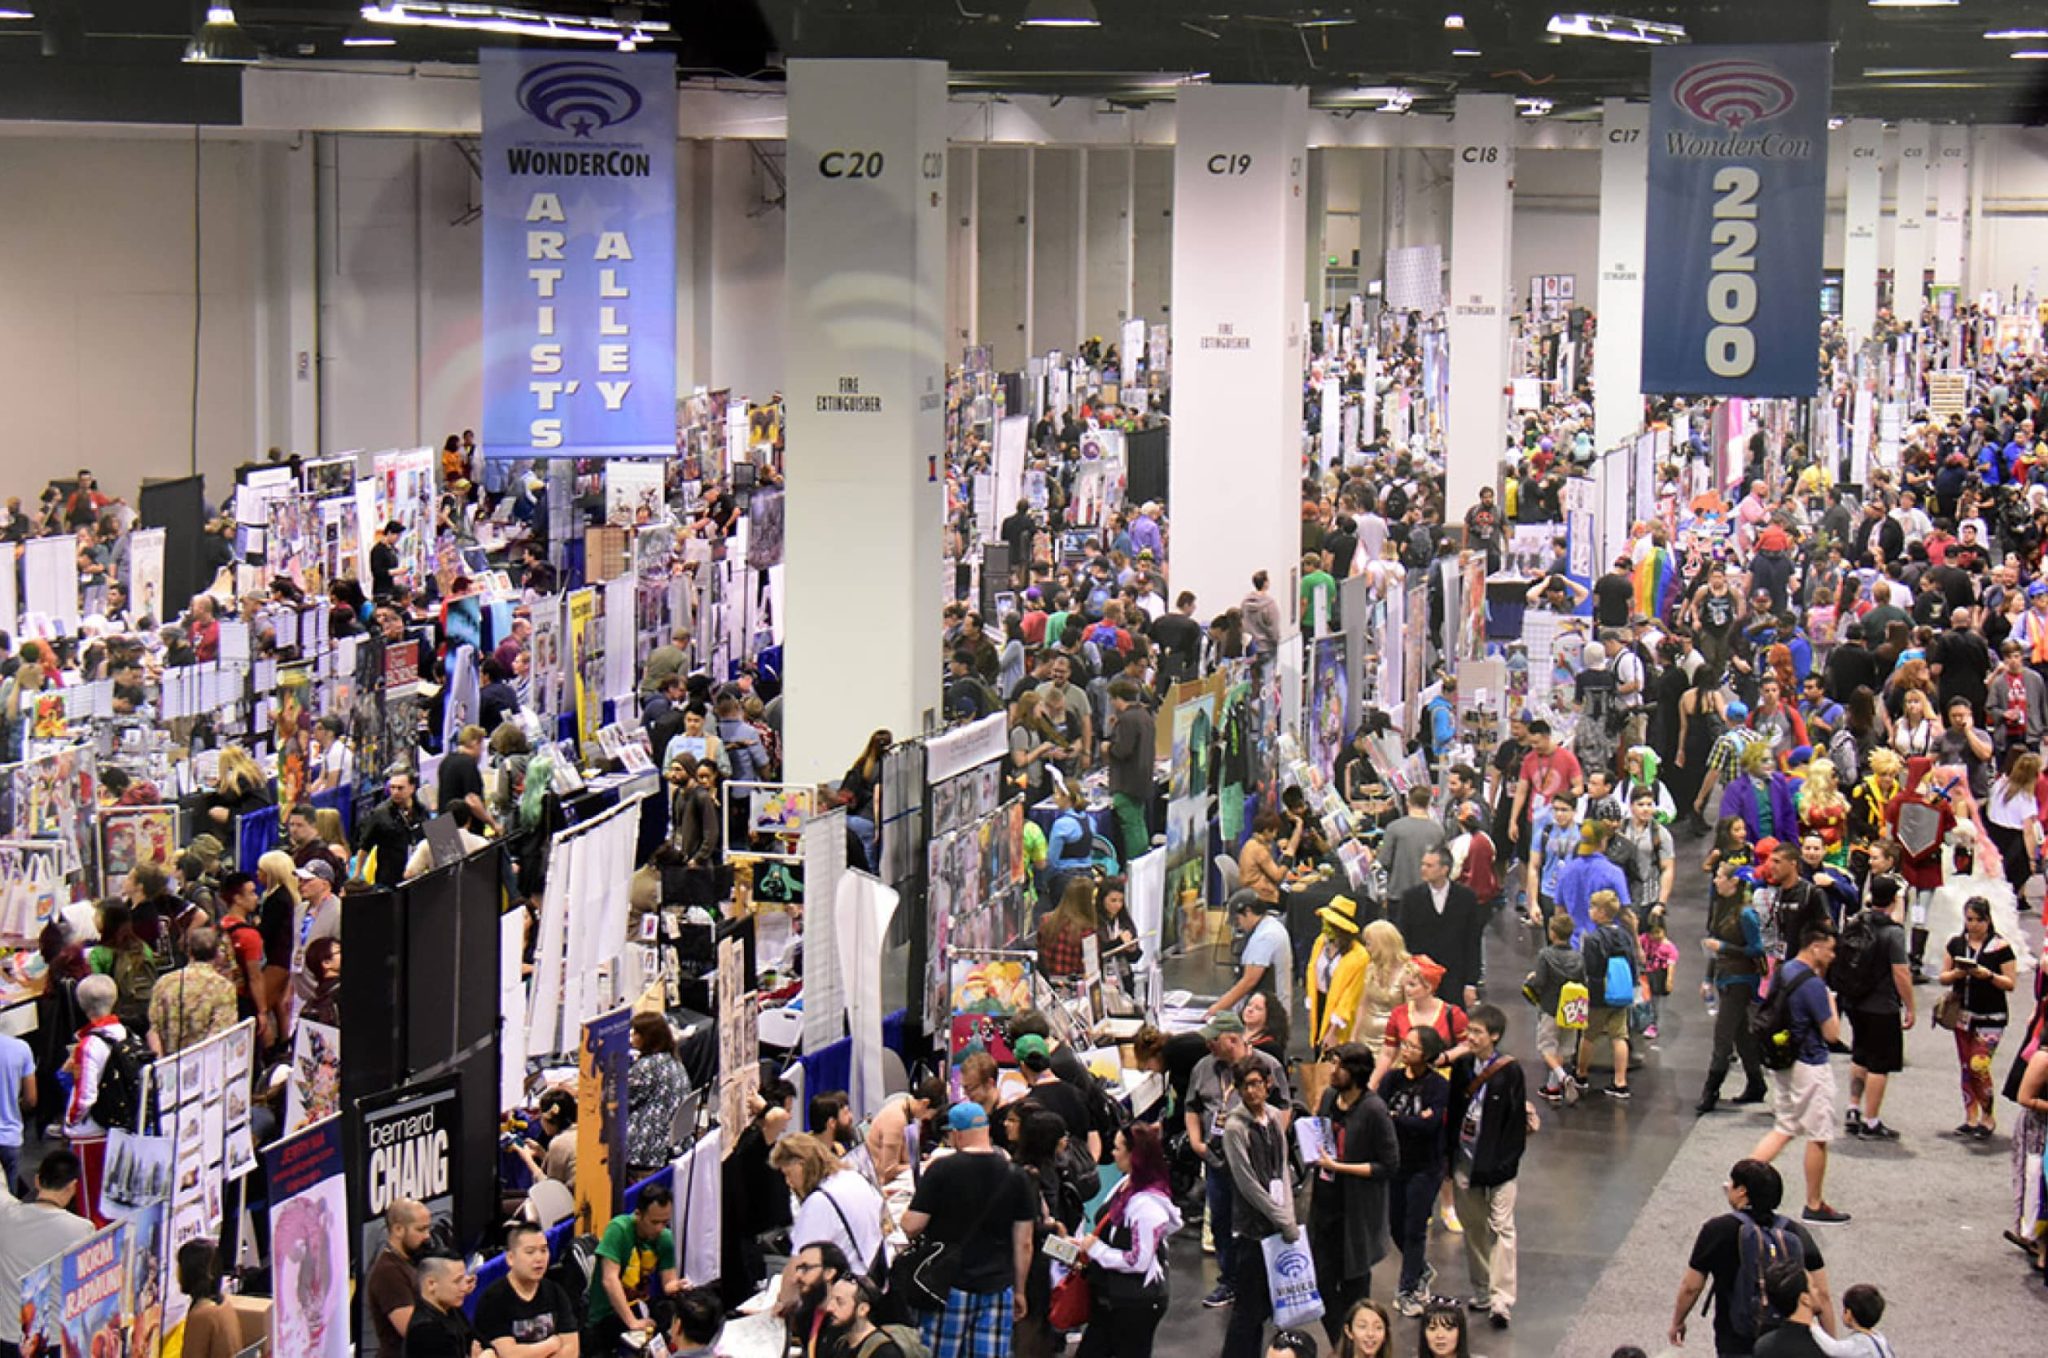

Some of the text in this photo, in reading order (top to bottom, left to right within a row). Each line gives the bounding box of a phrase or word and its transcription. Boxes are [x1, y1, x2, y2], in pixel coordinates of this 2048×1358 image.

[1608, 129, 1640, 143] C17
[1666, 131, 1810, 158] WonderCon
[818, 151, 884, 178] C20
[1207, 154, 1252, 175] C19
[1462, 147, 1498, 163] C18
[1705, 165, 1761, 378] 2200
[593, 231, 633, 411] ALLEY
[839, 376, 859, 393] FIRE
[817, 395, 882, 412] EXTINGUISHER
[369, 1104, 434, 1149] bernard
[370, 1129, 450, 1215] CHANG
